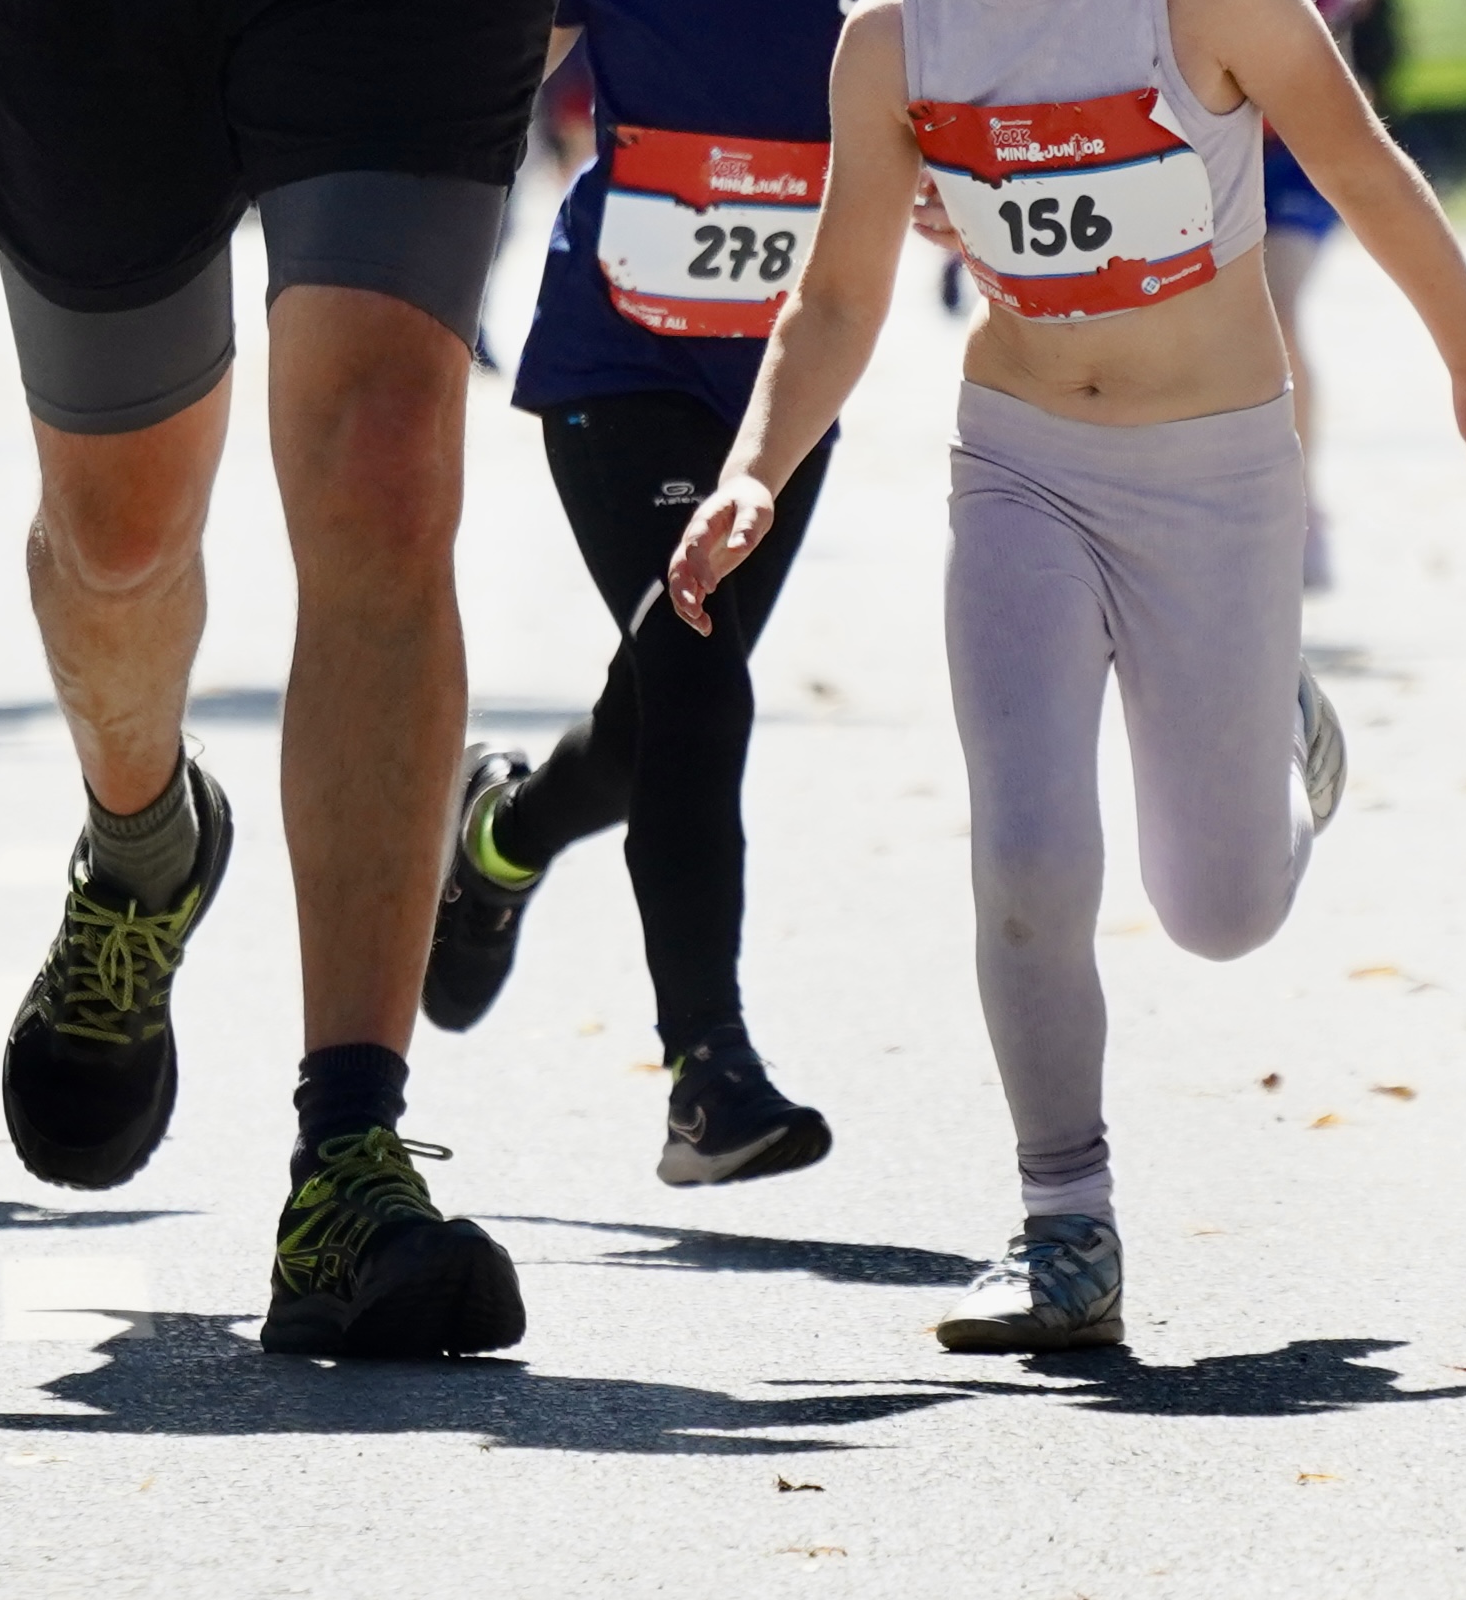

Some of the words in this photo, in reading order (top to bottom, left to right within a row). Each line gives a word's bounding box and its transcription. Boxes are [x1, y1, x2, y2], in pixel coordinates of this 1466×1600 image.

[991, 128, 1032, 146] YORK
[687, 224, 797, 283] 278
[998, 195, 1113, 257] 156
